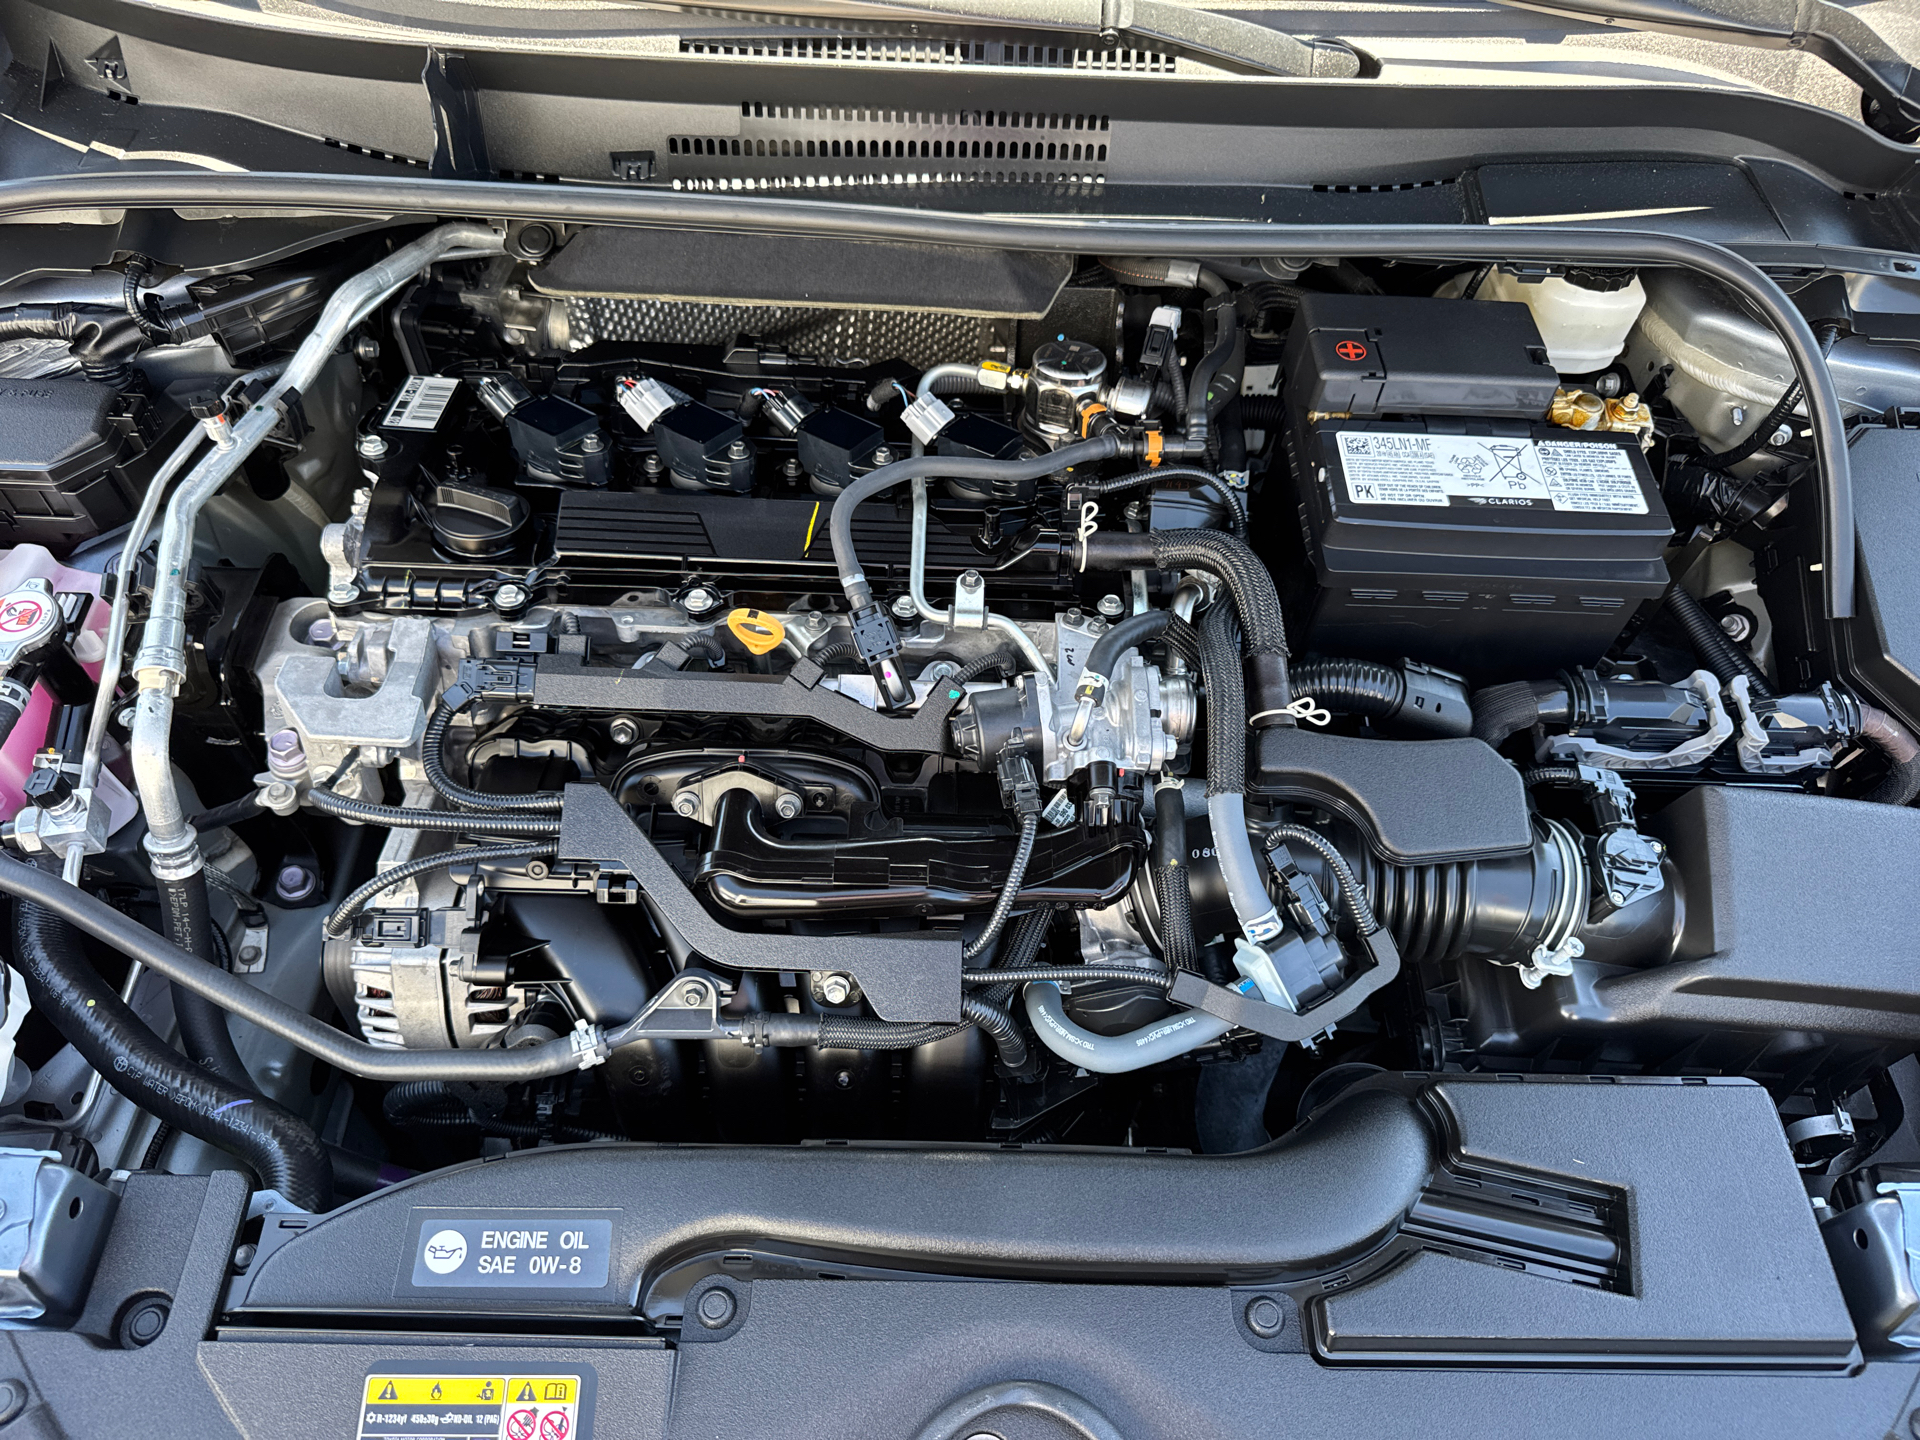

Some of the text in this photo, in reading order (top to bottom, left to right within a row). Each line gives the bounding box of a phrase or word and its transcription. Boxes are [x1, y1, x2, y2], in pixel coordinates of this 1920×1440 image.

[1373, 436, 1432, 451] 345LN1-MF
[1545, 440, 1617, 450] DANGER/POISON
[1354, 484, 1375, 499] PK
[1508, 480, 1527, 490] Pb
[1488, 498, 1533, 506] CLARIOS
[28, 773, 55, 791] H
[177, 887, 189, 908] 17LP
[143, 1074, 169, 1098] WATER
[481, 1230, 590, 1249] ENGINE OIL
[477, 1256, 582, 1274] SAE 0W-8
